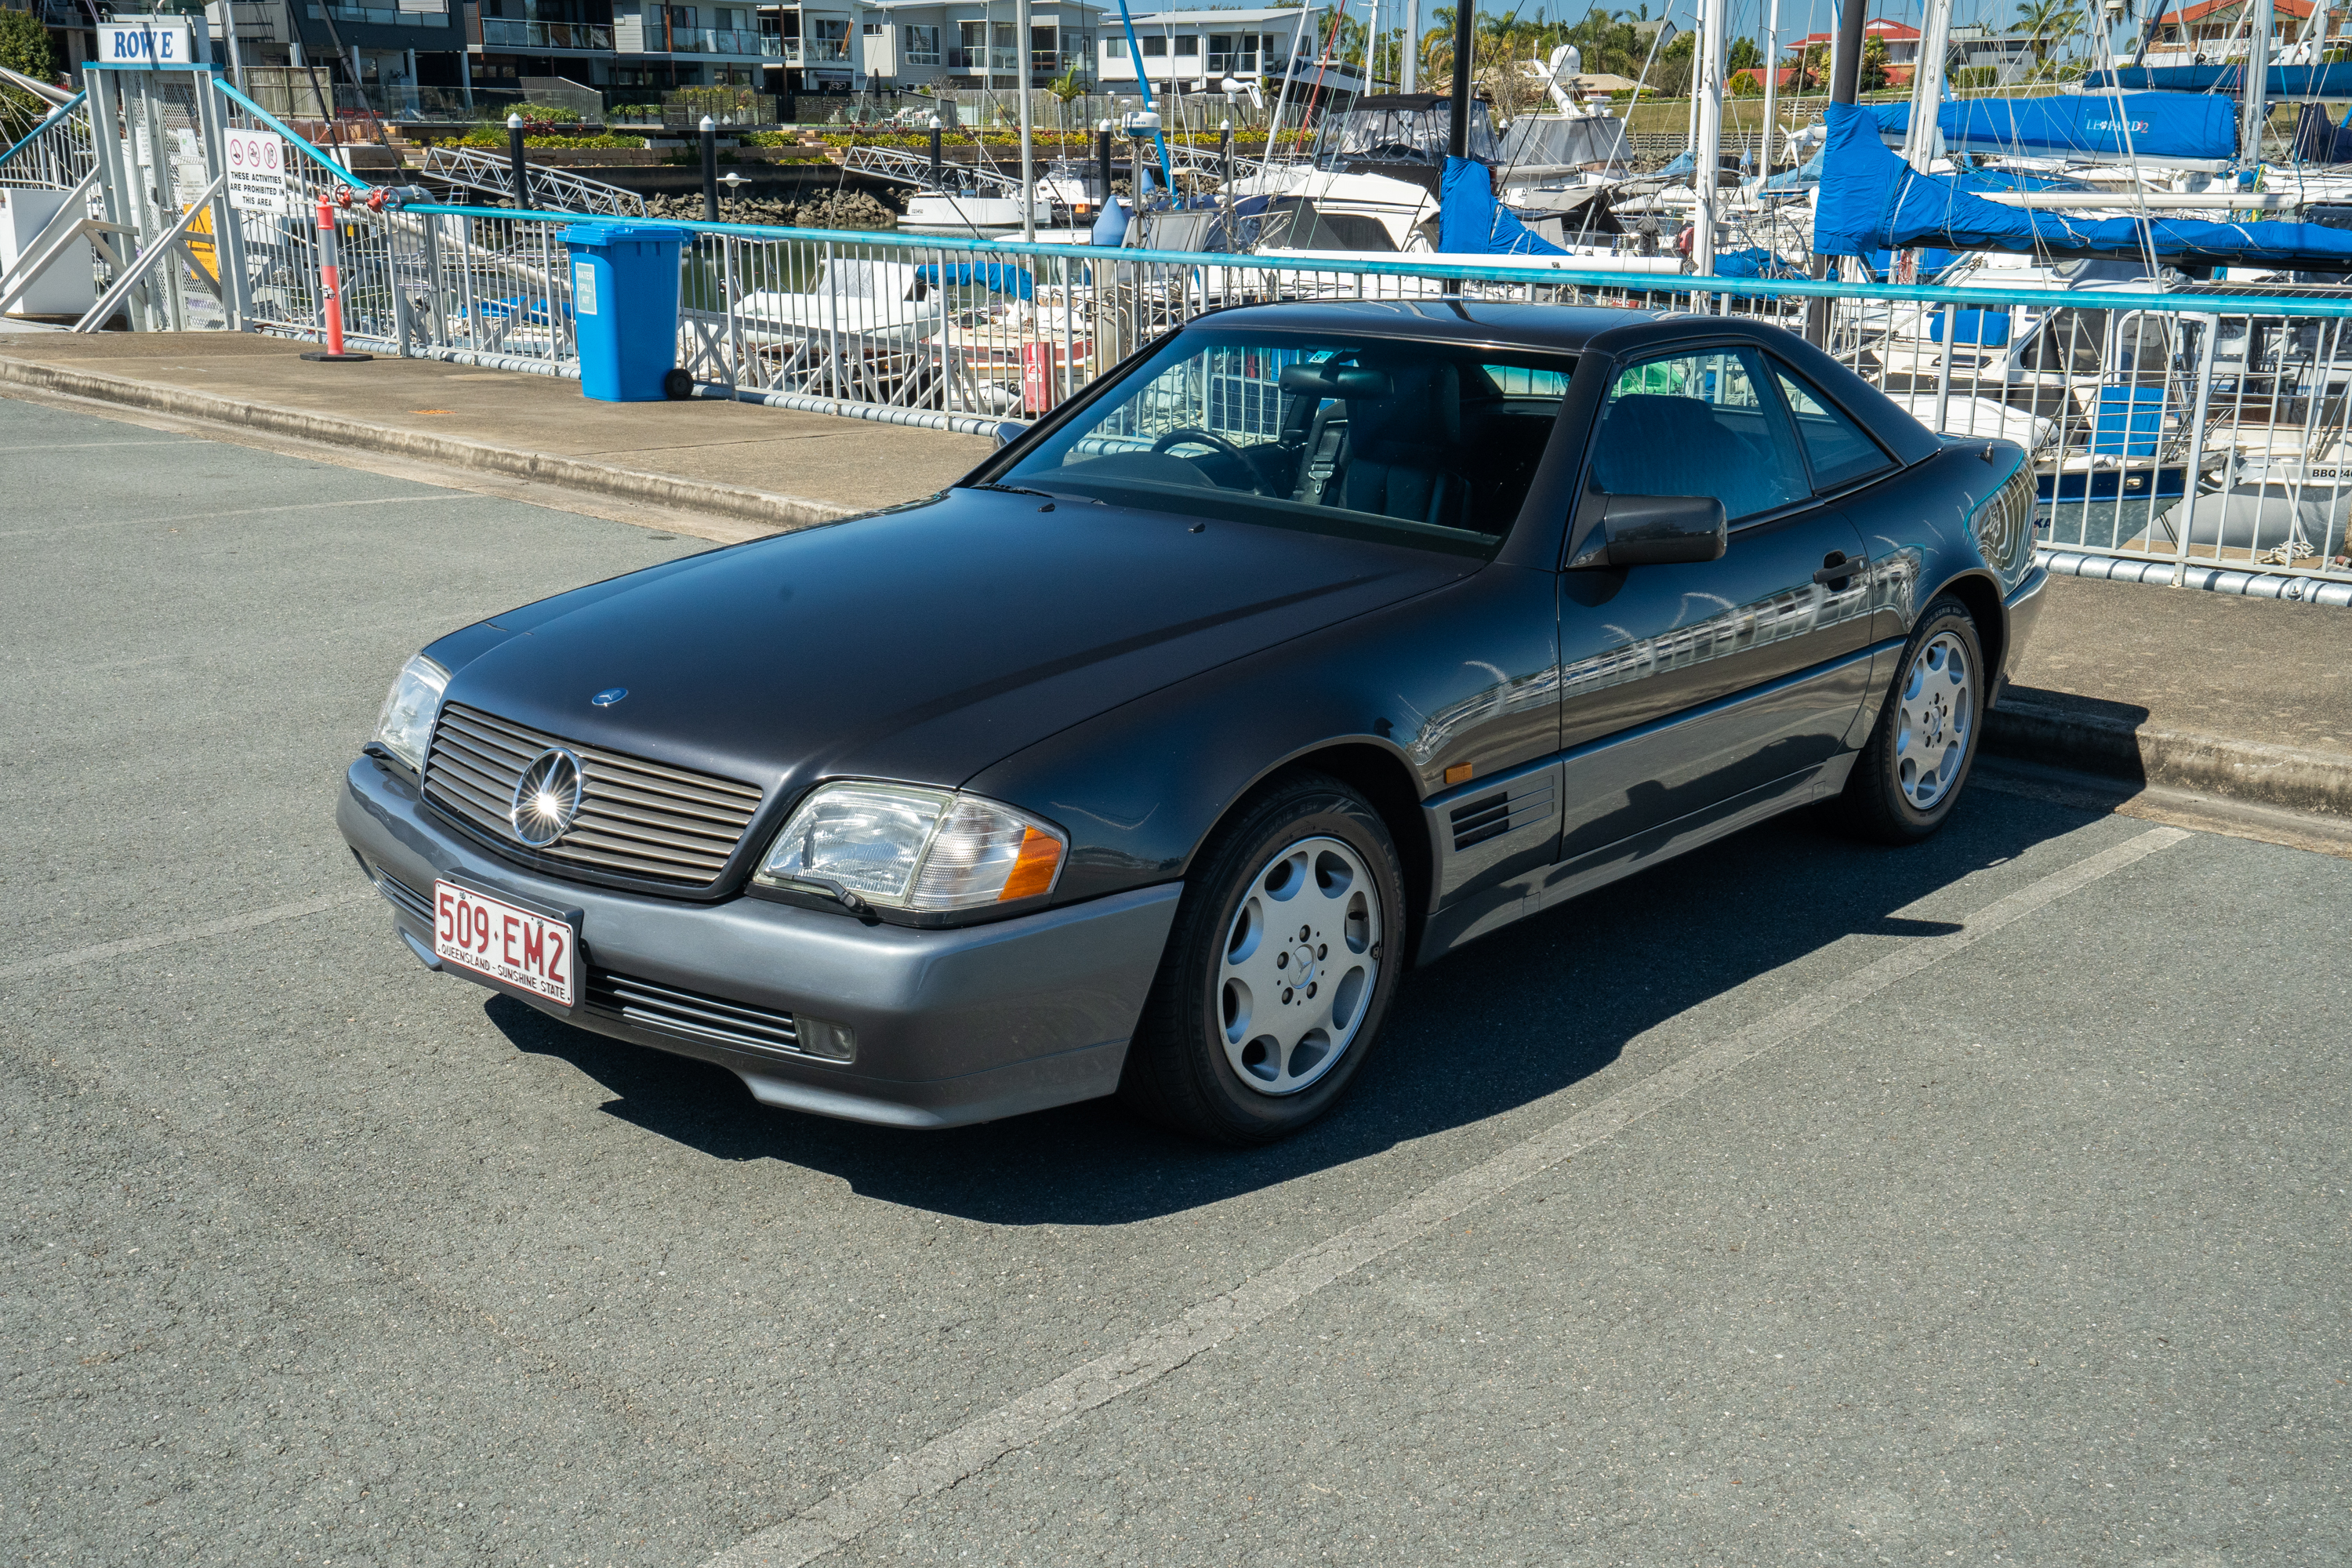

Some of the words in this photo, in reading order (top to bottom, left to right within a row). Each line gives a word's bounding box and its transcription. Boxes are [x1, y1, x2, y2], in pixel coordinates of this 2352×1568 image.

[114, 31, 172, 58] ROWE
[230, 171, 249, 181] THESE
[252, 173, 282, 184] ACTIVITIES
[230, 183, 241, 191] ARE
[244, 184, 277, 195] PROHIBITED
[242, 196, 255, 205] THIS
[257, 198, 272, 207] AREA
[576, 270, 593, 281] WATER
[579, 283, 593, 292] SPILL
[2313, 469, 2352, 477] BBQ24
[440, 892, 488, 953] 509
[503, 914, 565, 985] EM2
[441, 944, 490, 971] QUEENSLAND
[497, 964, 538, 989] SUNSHINE
[540, 980, 565, 1000] STATE
